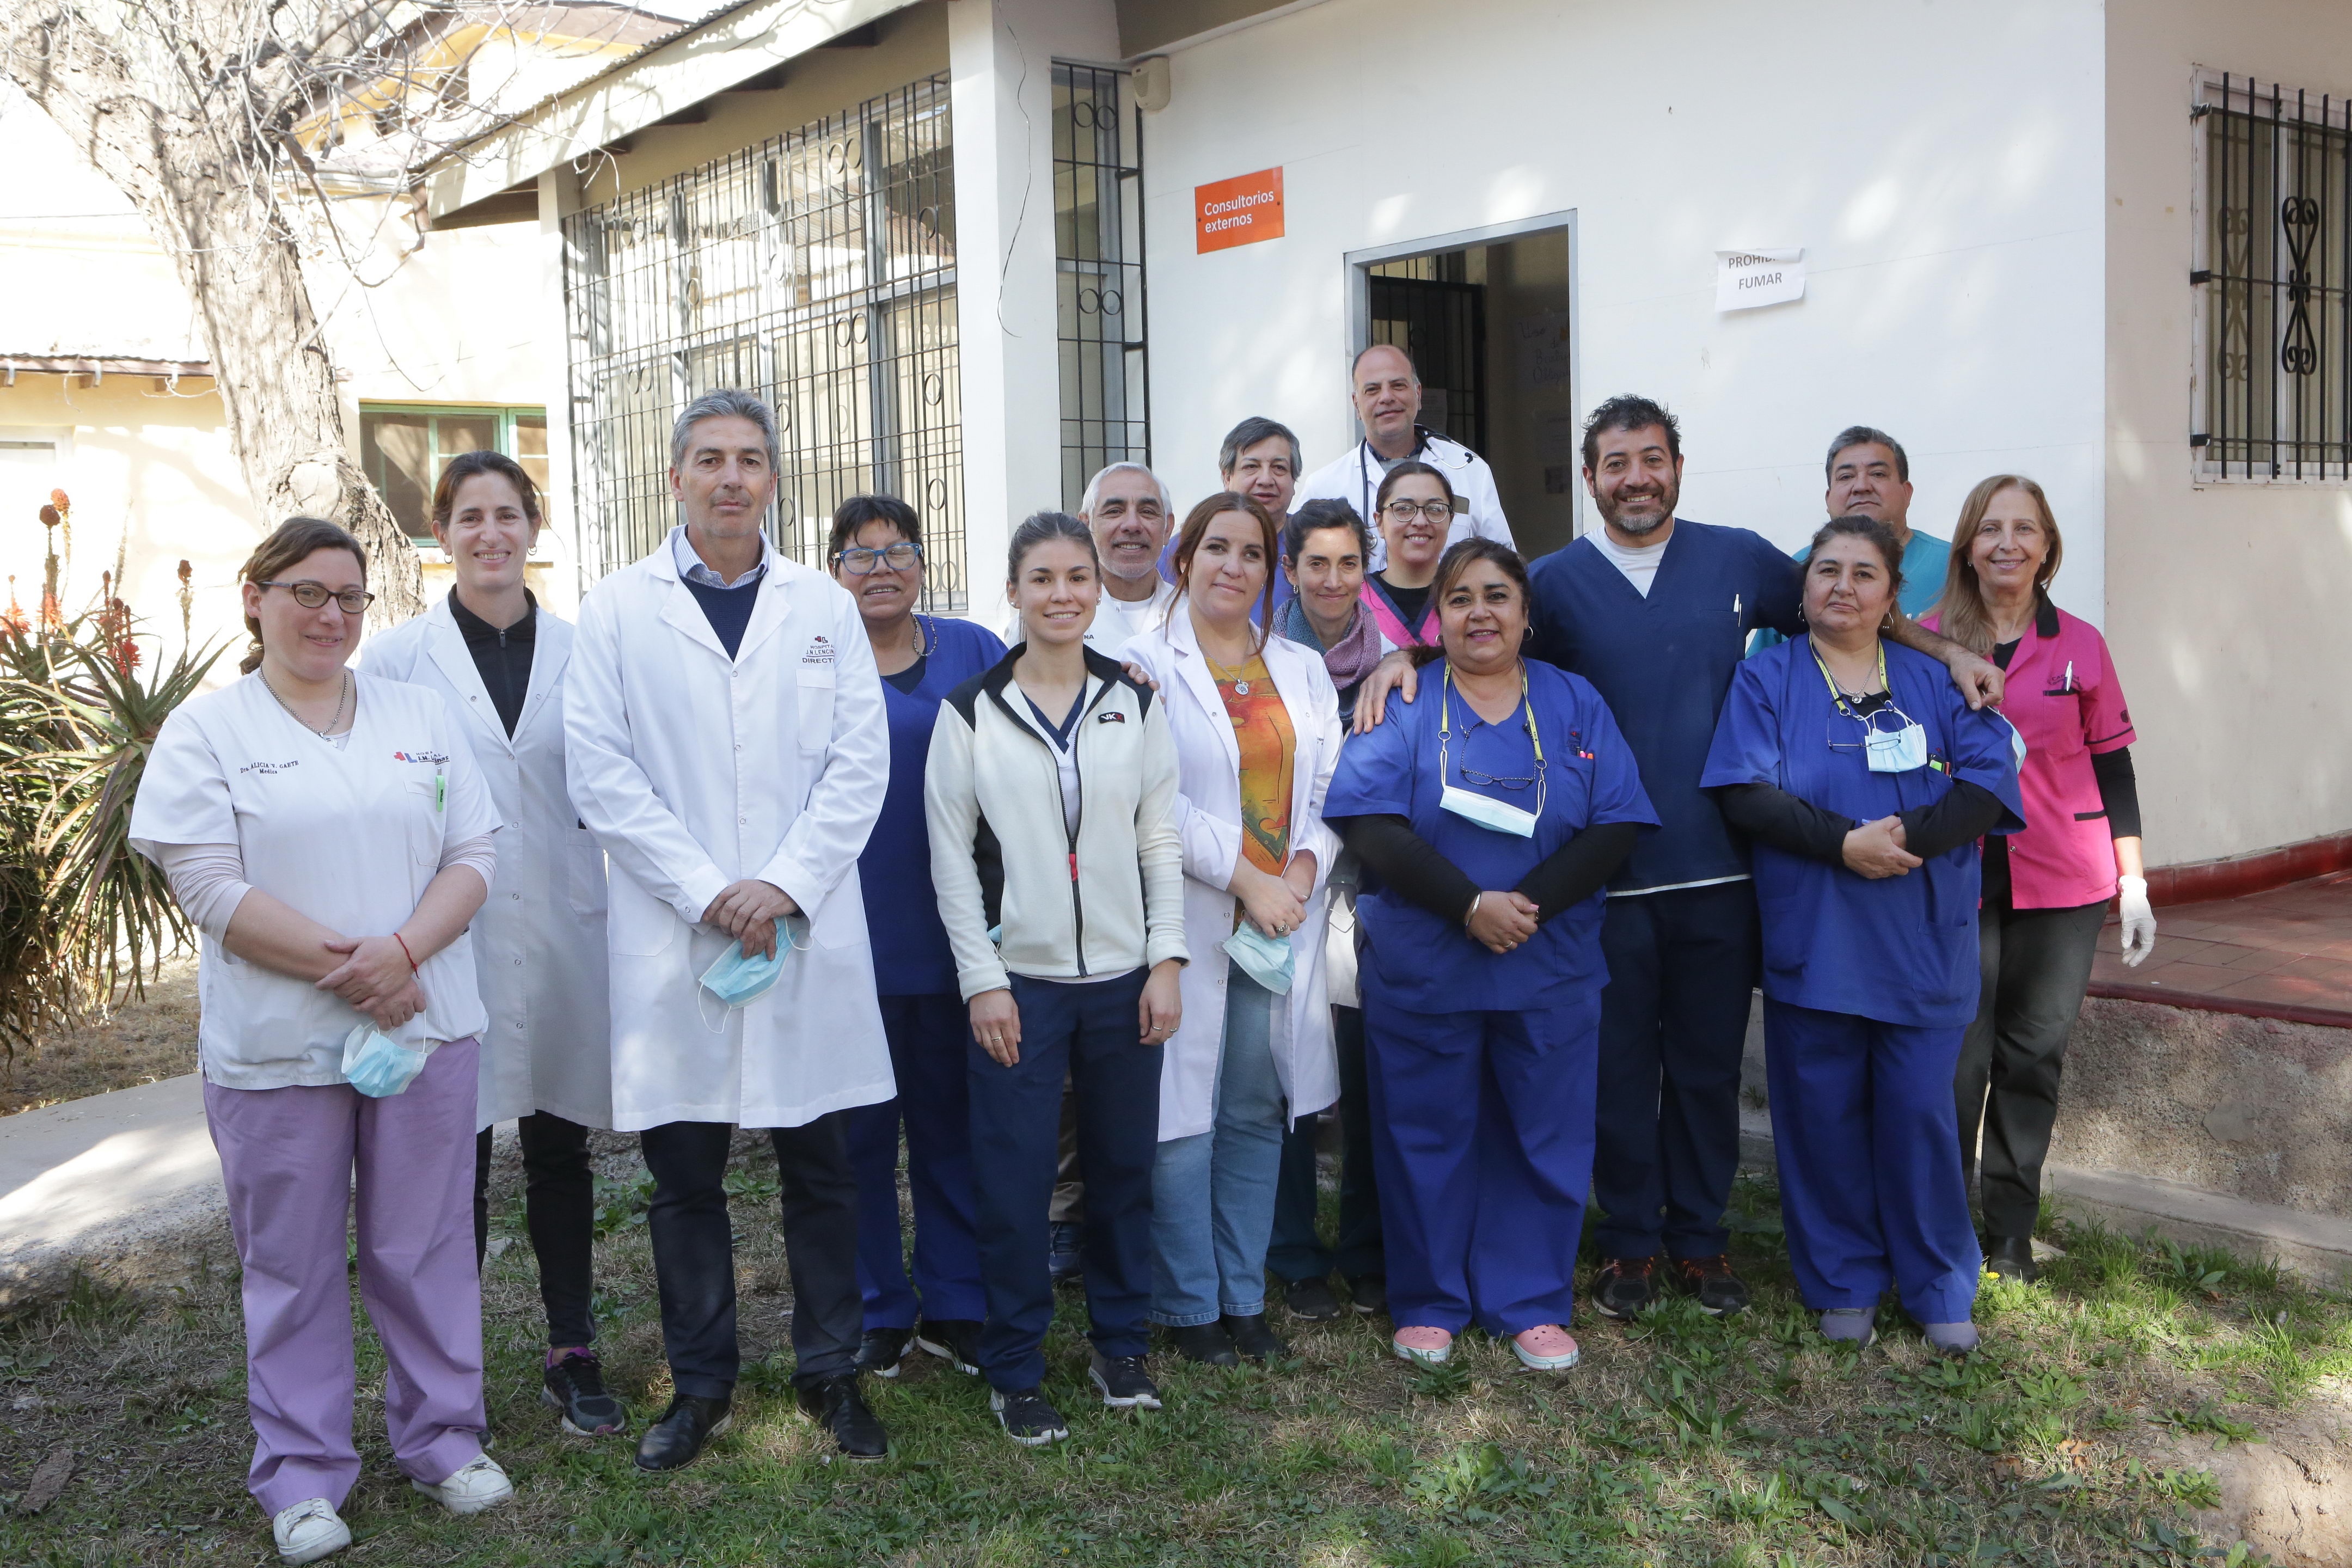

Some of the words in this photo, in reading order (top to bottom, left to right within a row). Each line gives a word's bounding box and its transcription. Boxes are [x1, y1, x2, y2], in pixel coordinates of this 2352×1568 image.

[1205, 191, 1274, 216] Consultorios
[1205, 213, 1252, 233] externos
[1738, 272, 1782, 290] FUMAR
